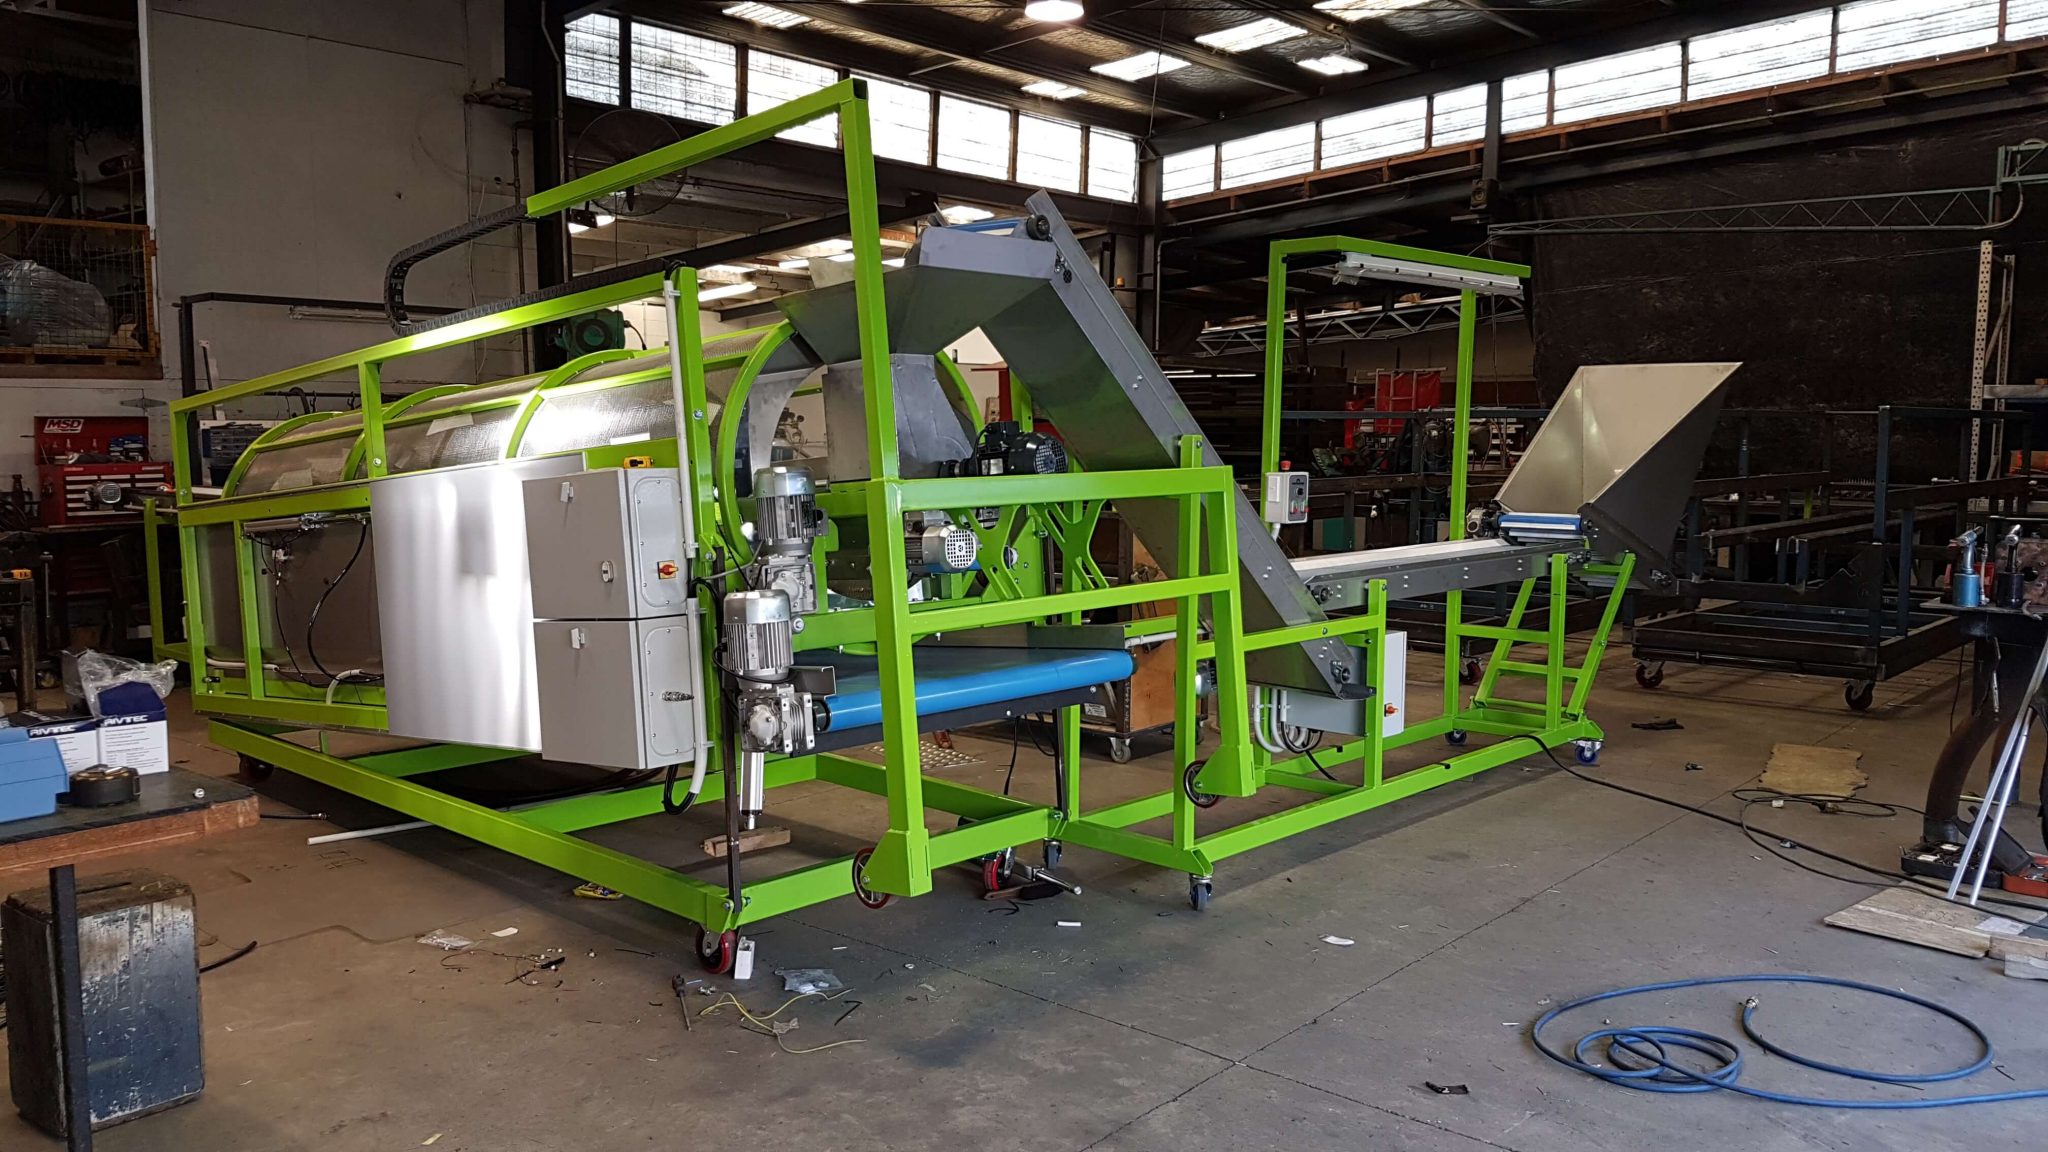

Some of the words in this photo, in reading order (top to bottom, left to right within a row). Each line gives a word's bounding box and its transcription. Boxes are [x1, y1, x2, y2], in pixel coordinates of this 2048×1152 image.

[47, 419, 81, 429] MSD
[104, 714, 148, 726] RIVTEC
[30, 724, 76, 736] RIVTEC
